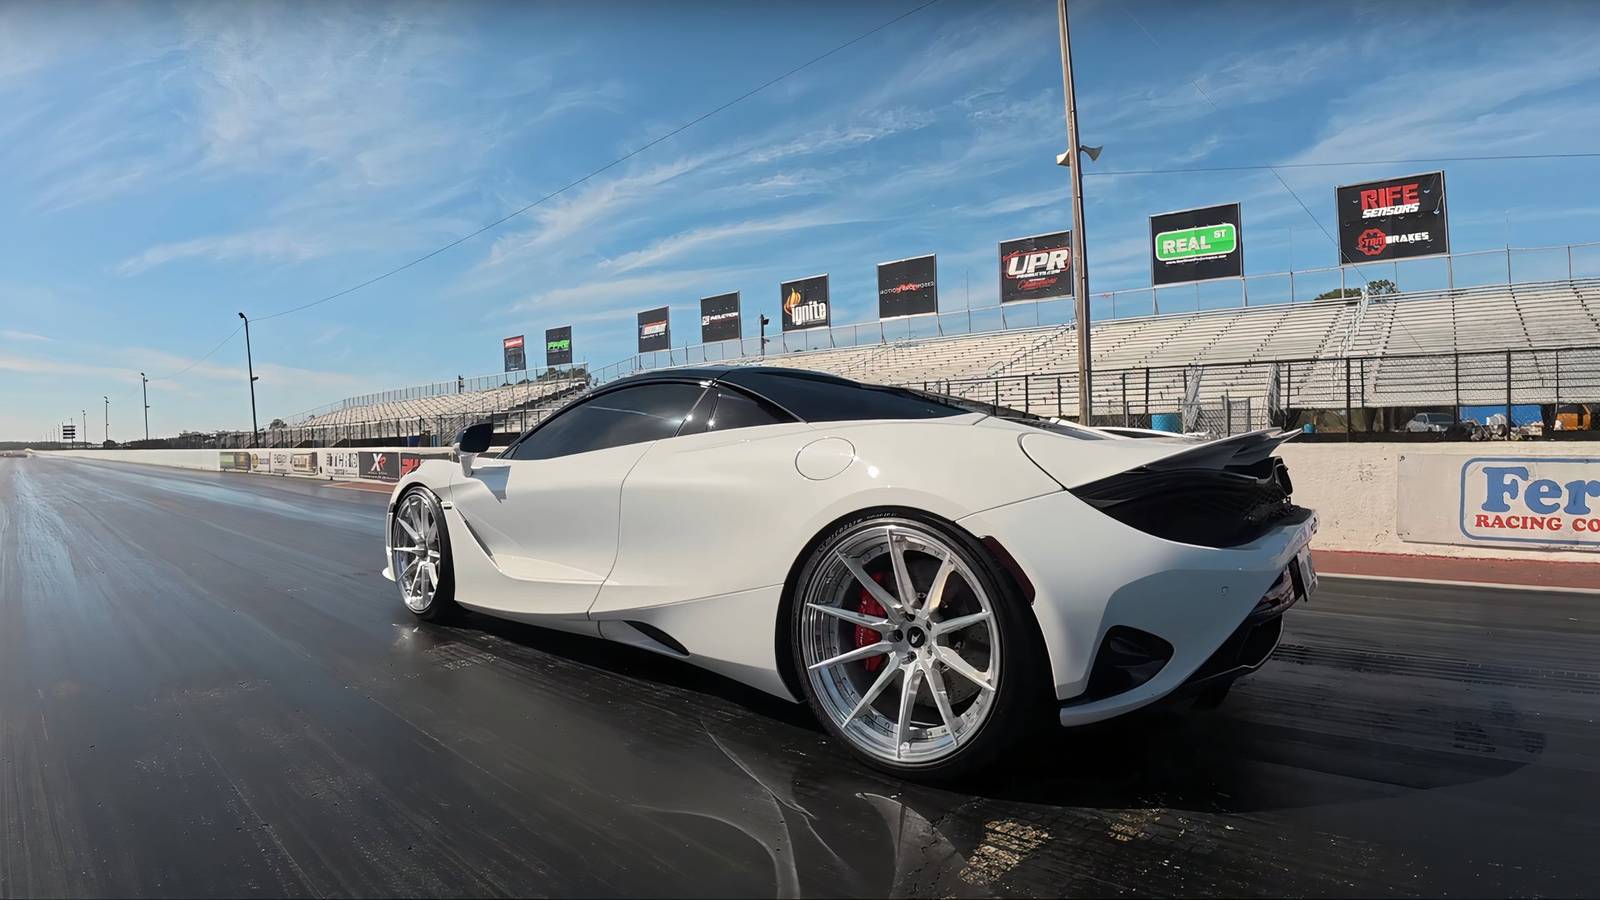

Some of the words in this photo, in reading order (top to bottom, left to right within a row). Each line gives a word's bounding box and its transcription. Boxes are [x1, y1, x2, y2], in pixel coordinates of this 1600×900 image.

[1360, 183, 1421, 210] RIFE
[1361, 202, 1421, 219] SENSORS
[1162, 235, 1211, 255] REAL
[1213, 229, 1227, 239] ST
[1385, 231, 1430, 244] BRAKES
[1008, 249, 1069, 276] UPR
[791, 300, 827, 325] ignite
[1475, 514, 1563, 531] RACING
